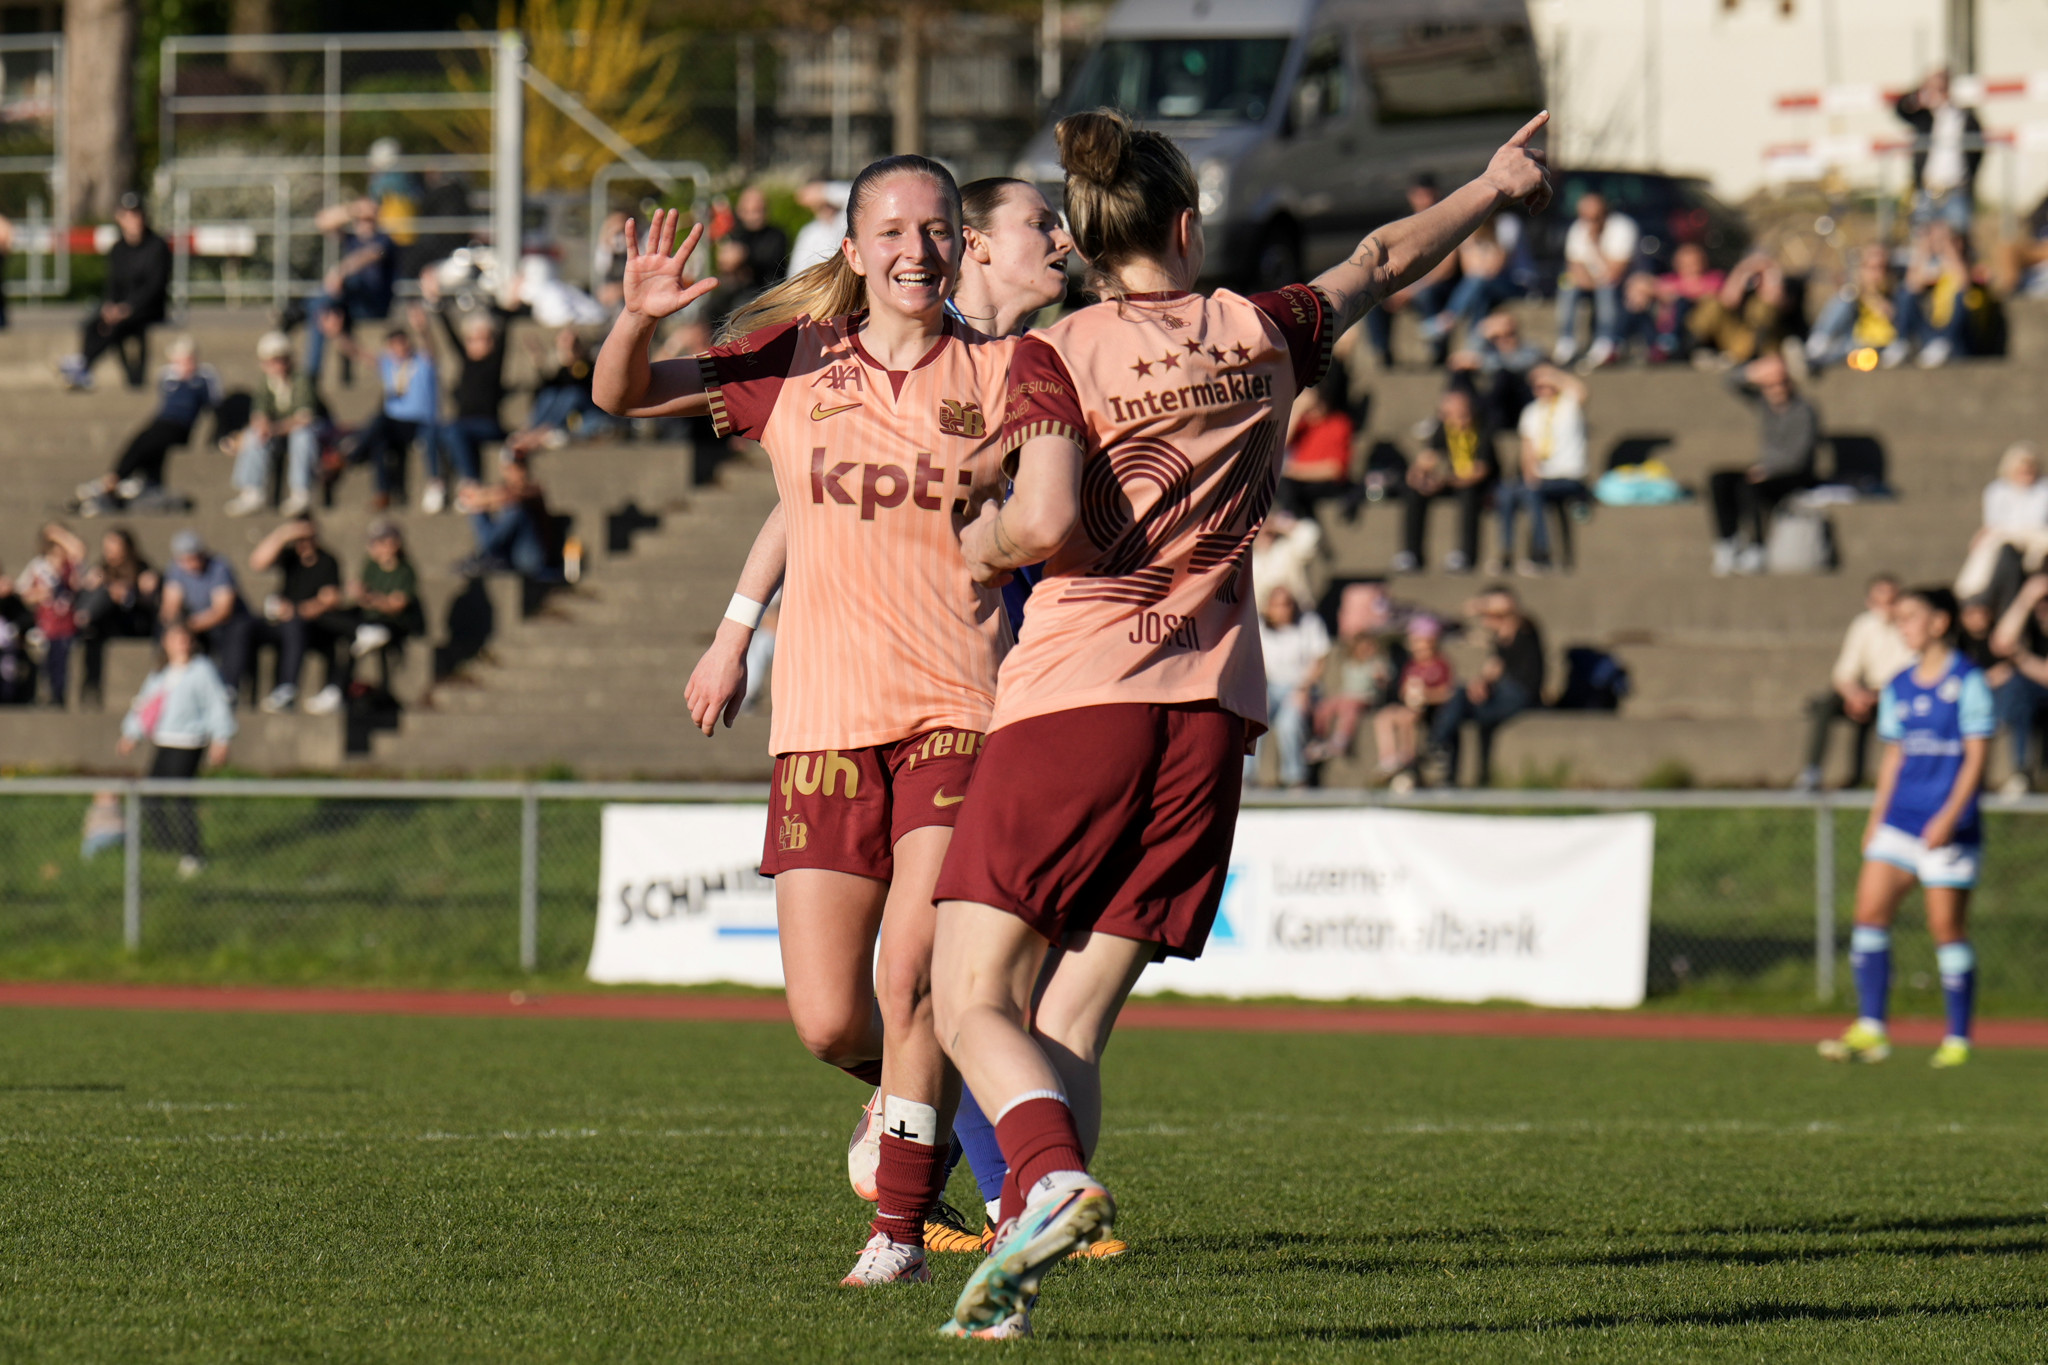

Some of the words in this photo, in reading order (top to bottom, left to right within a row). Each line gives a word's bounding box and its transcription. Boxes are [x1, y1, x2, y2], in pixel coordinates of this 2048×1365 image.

[811, 365, 863, 391] AXA
[1006, 381, 1064, 404] AGNESIUM
[1109, 370, 1273, 423] Intermakler
[781, 750, 859, 811] yuh
